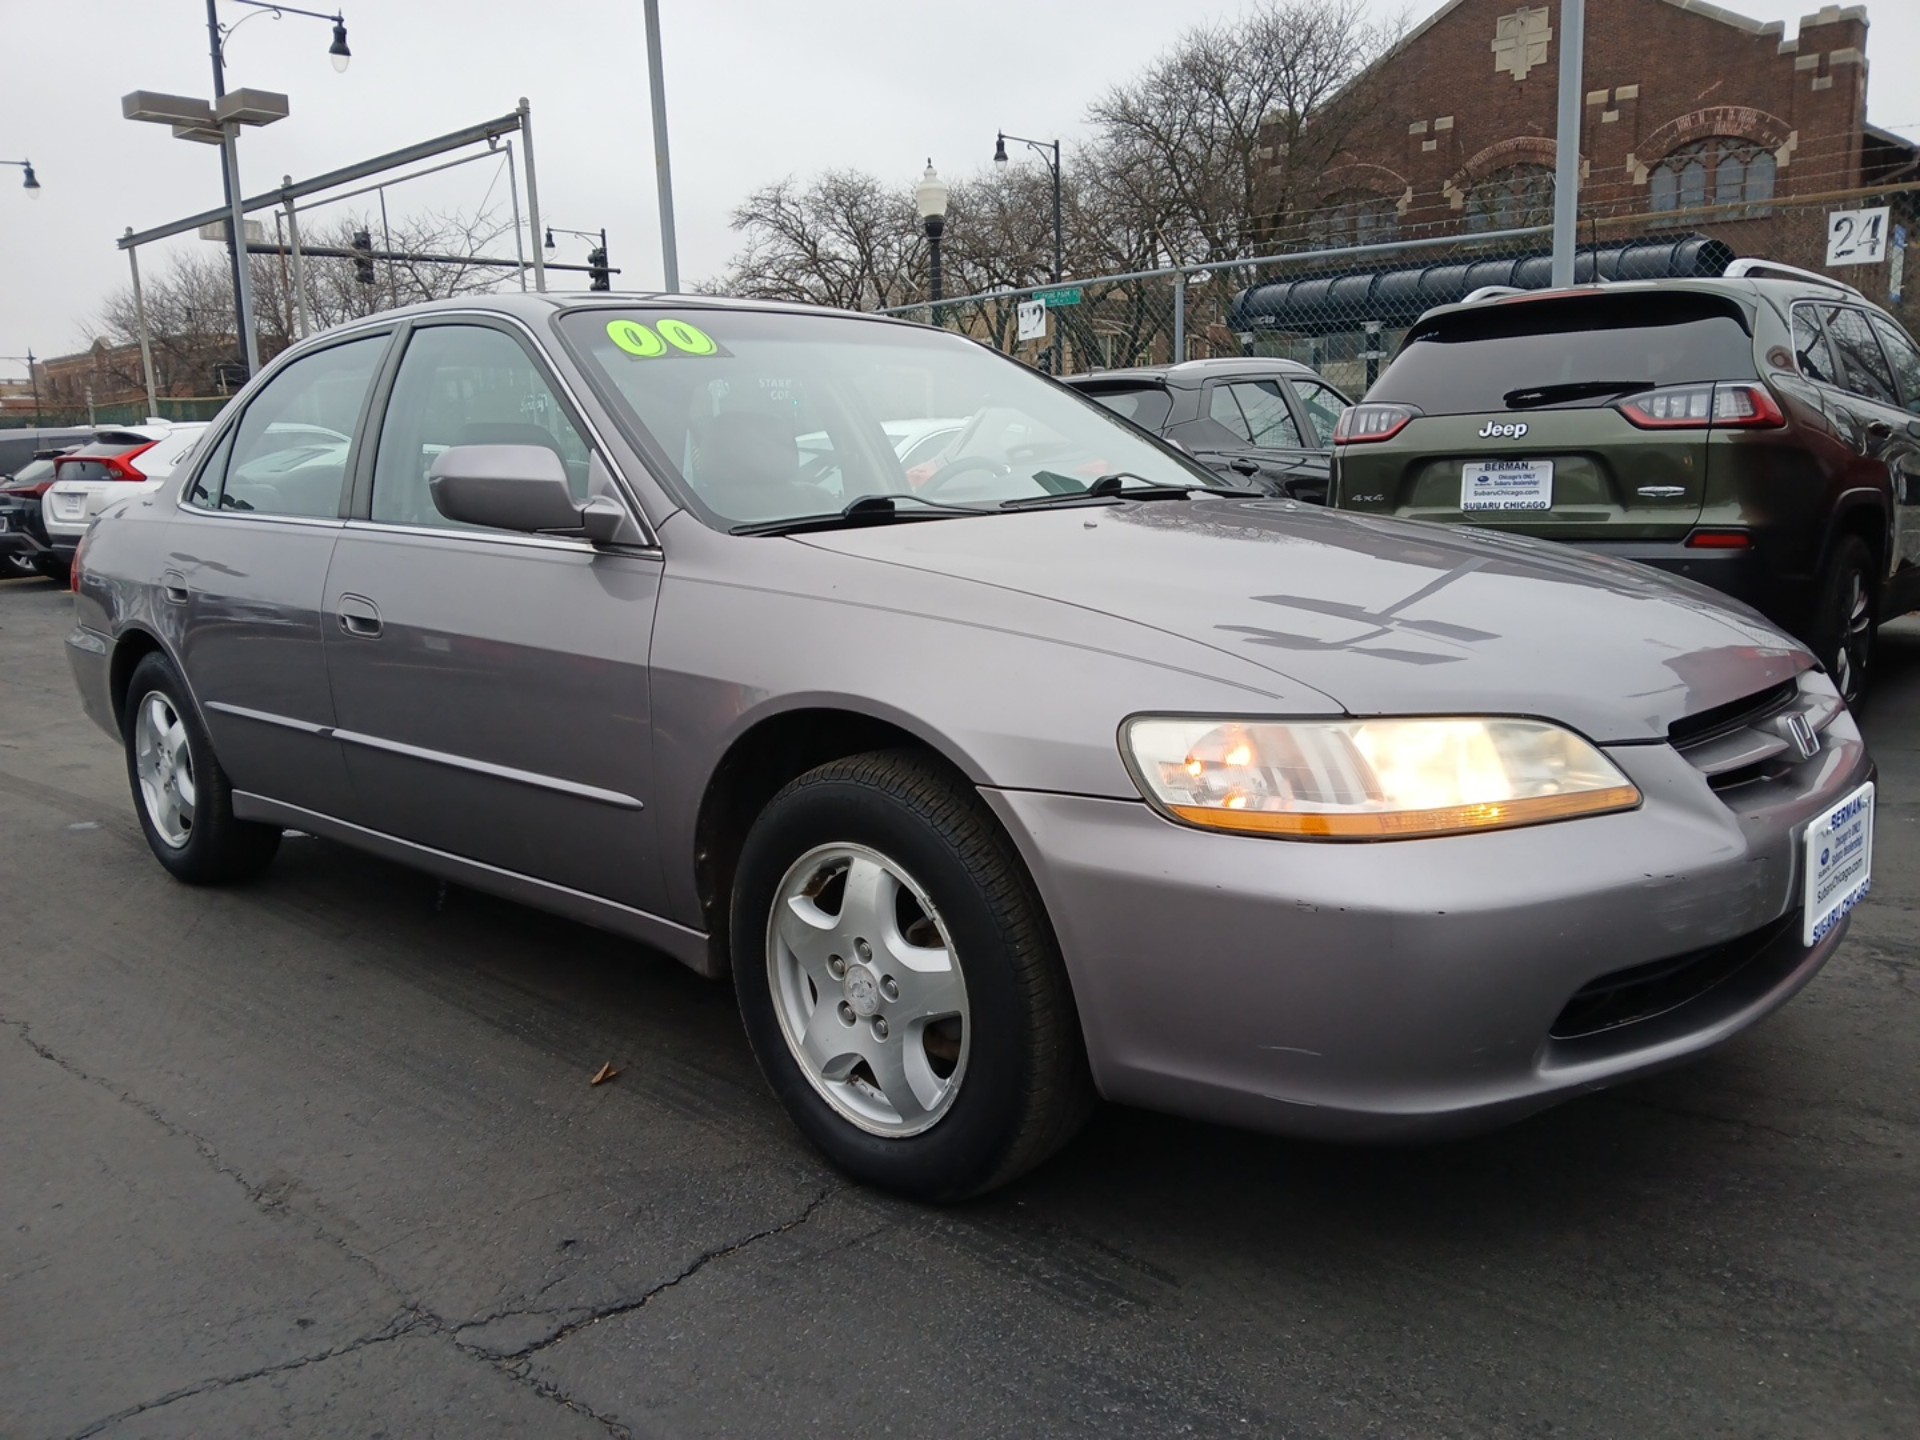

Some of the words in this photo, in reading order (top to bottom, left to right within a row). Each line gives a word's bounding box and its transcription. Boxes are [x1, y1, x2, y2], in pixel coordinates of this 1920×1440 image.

[1834, 214, 1882, 259] 24
[606, 319, 718, 356] 00
[1479, 421, 1528, 438] Jeep
[1485, 462, 1528, 471] BERMAN
[1463, 502, 1500, 510] SUBARU
[1503, 501, 1547, 509] CHICAGO
[1831, 795, 1862, 831] BERMAN
[1817, 857, 1863, 904] SubaruChicago.com
[1813, 903, 1840, 944] SUBARU
[1842, 877, 1870, 916] CHICAGO
